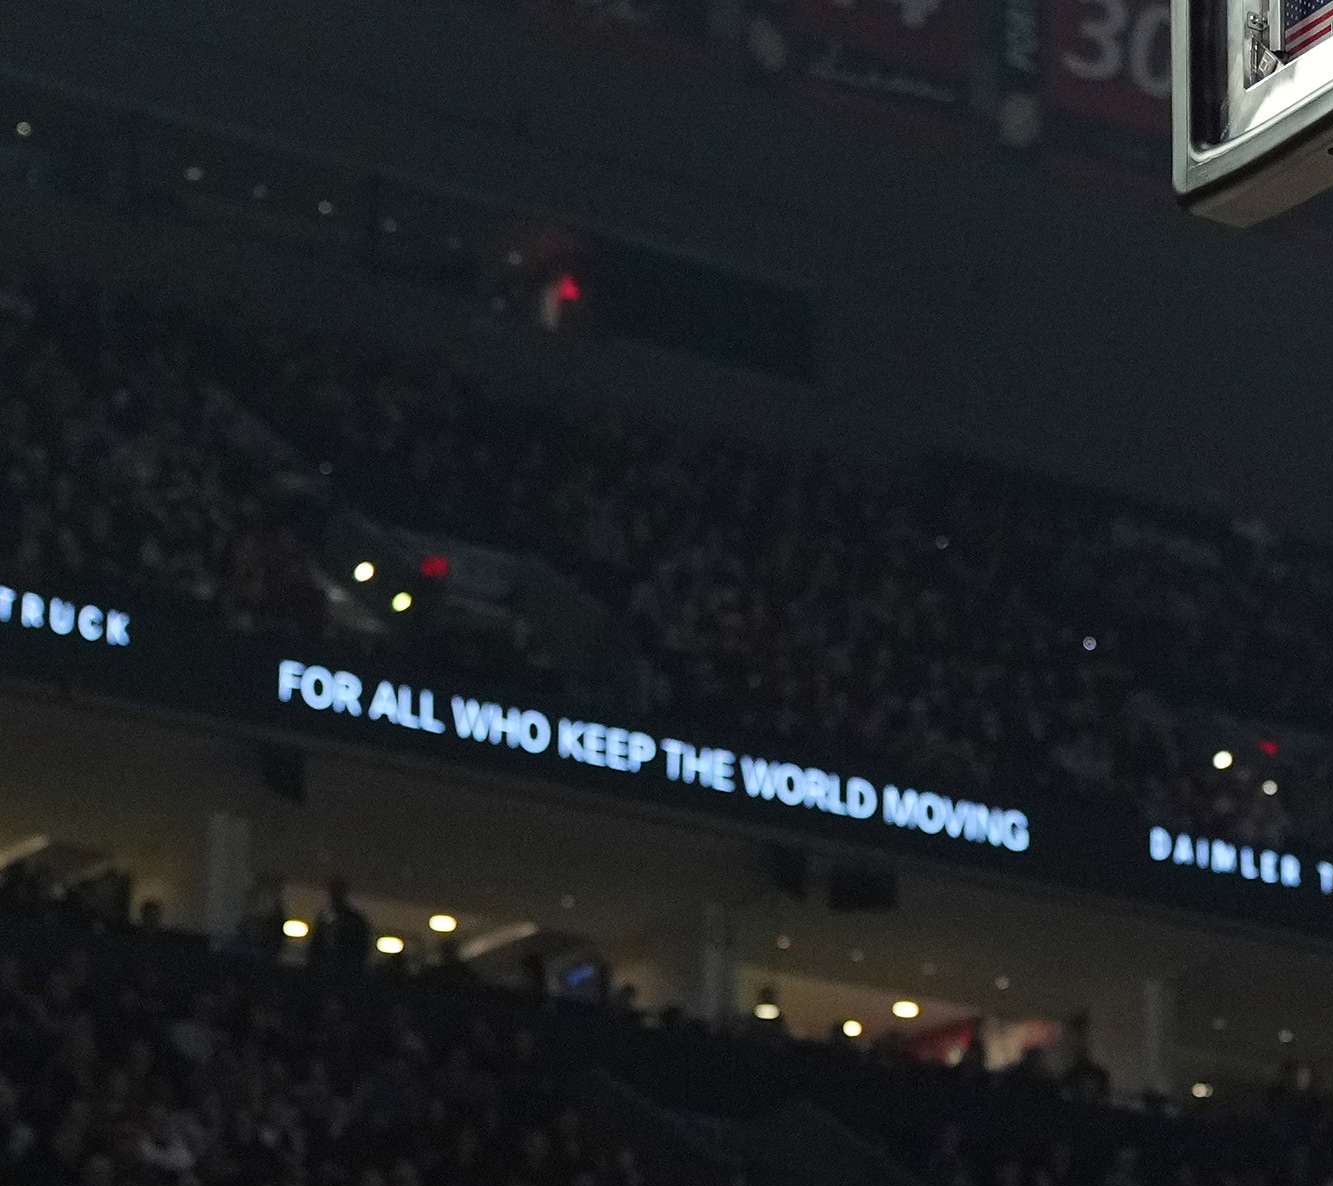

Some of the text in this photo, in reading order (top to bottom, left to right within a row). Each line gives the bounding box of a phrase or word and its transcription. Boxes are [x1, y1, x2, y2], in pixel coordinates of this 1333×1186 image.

[278, 659, 1030, 852] FOR ALL WHO KEEP THE WORLD MOVING
[1150, 826, 1301, 888] DAIMLER
